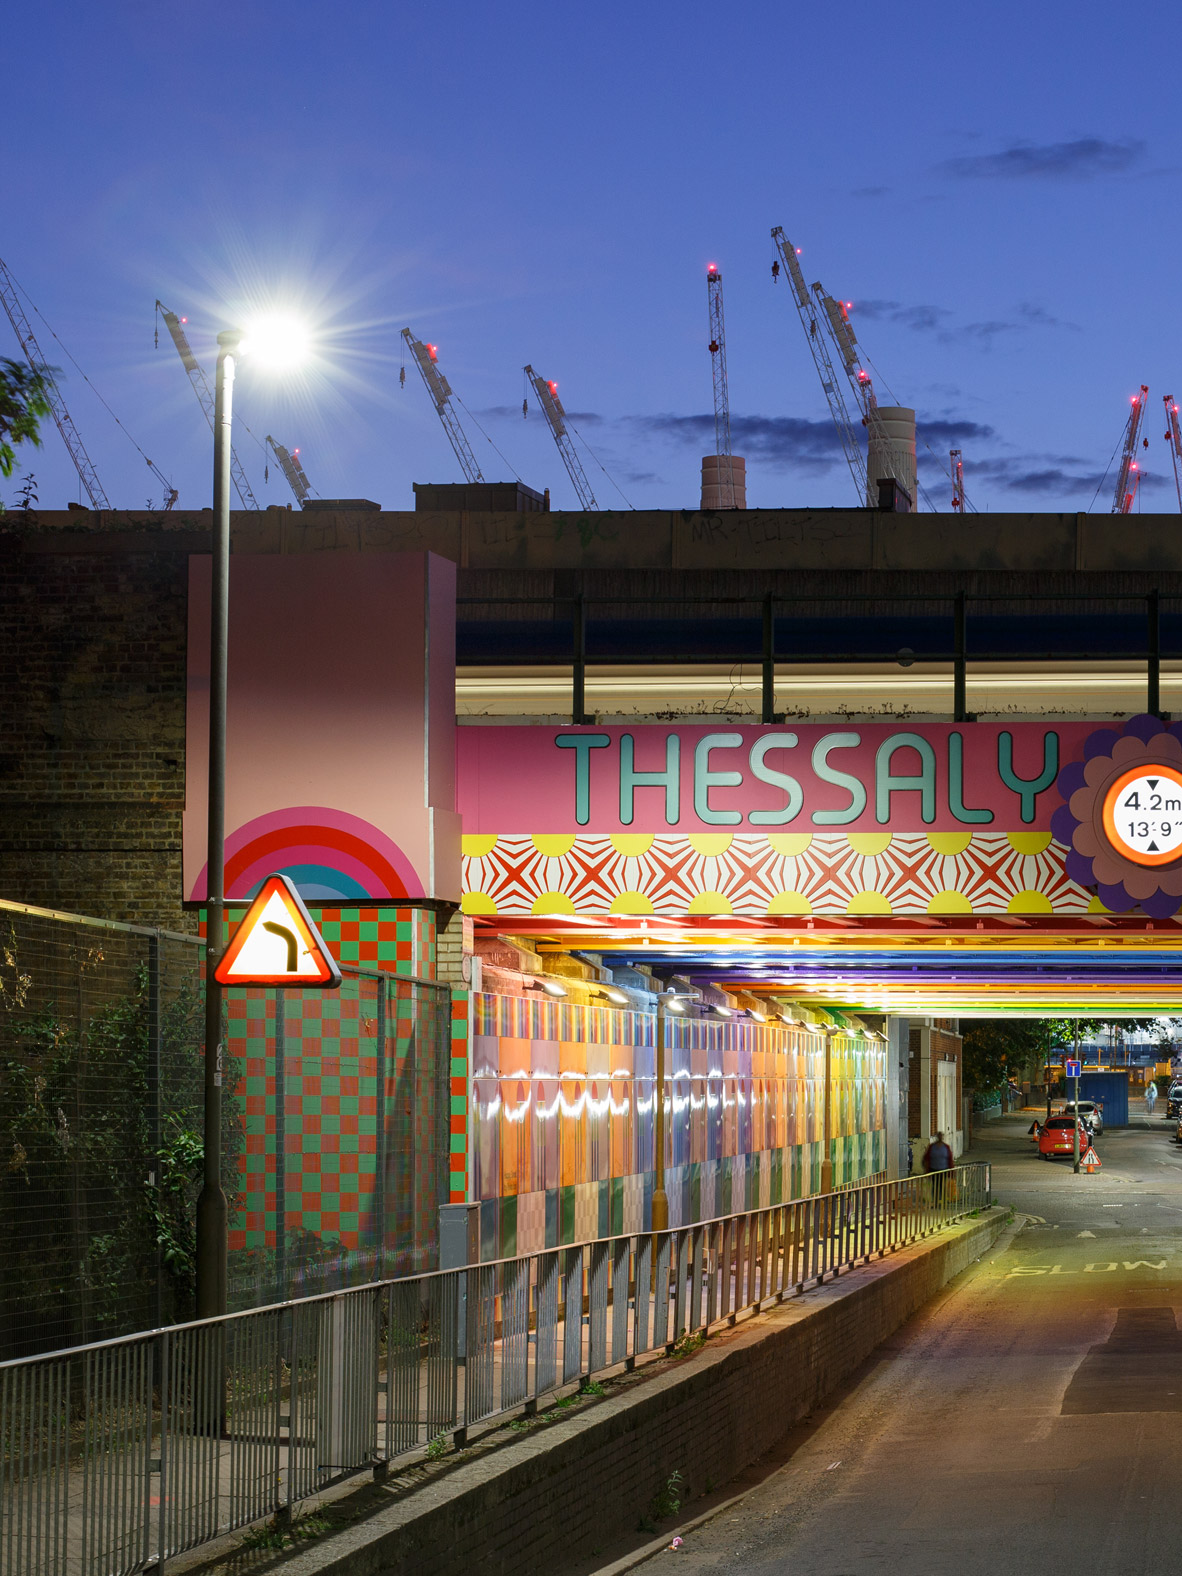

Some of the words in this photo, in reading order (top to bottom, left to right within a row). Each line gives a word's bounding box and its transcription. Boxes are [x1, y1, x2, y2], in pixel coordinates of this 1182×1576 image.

[554, 731, 1058, 826] THESSALY
[1124, 791, 1182, 811] 4.2m
[1005, 1260, 1168, 1278] SLOW
